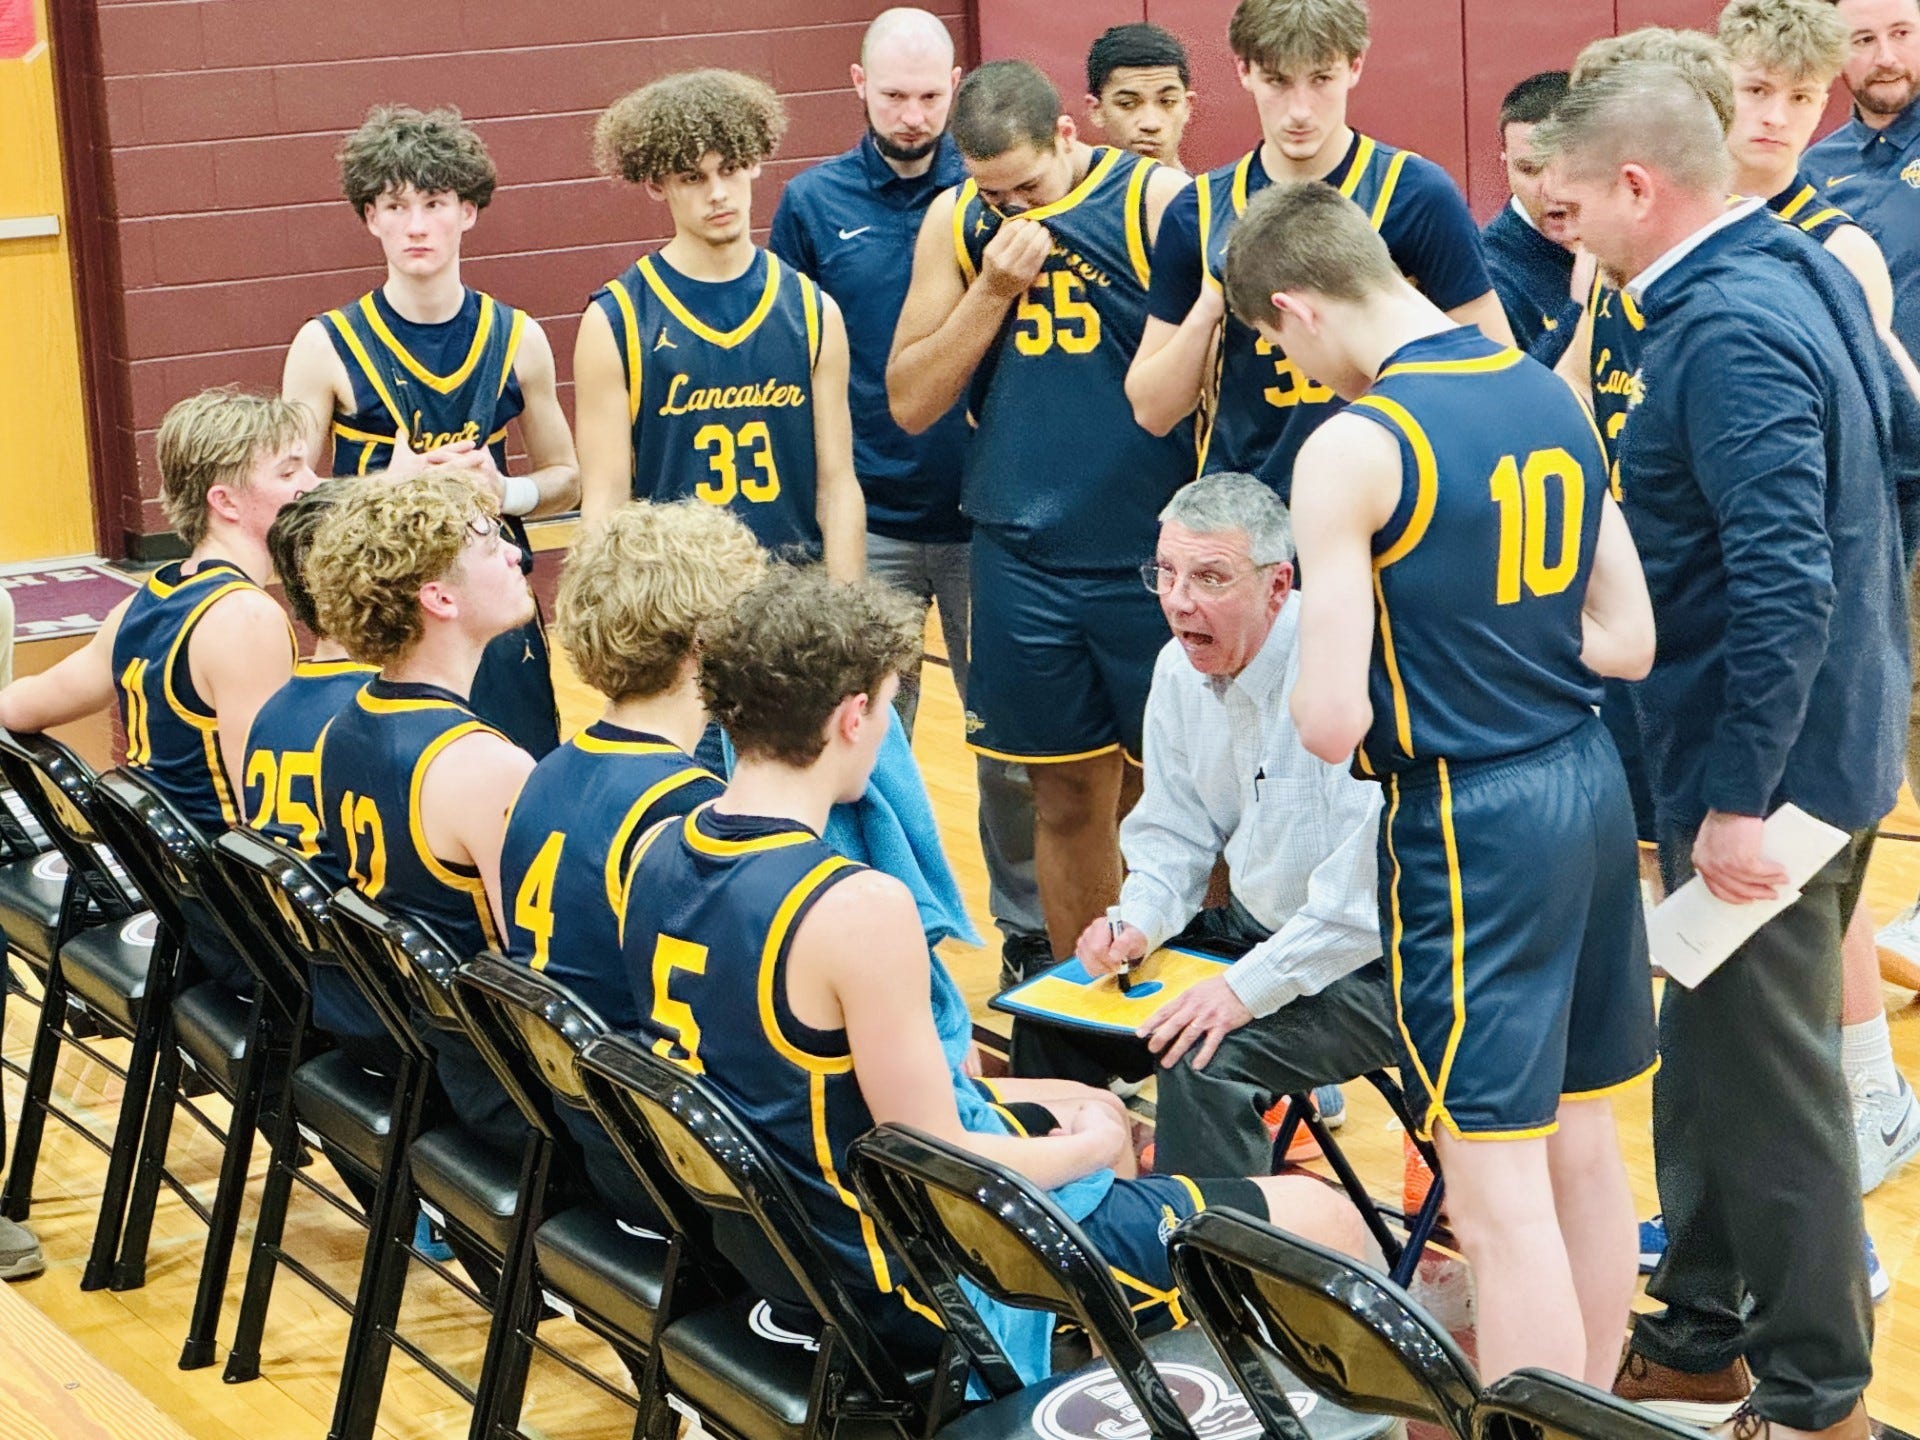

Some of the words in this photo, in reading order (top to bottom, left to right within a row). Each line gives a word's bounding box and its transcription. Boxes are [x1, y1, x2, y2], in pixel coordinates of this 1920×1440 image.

[1015, 270, 1100, 356] 55
[659, 374, 805, 416] Lancaster
[694, 421, 781, 505] 33
[1490, 447, 1584, 605] 10
[121, 657, 154, 771] 11
[245, 750, 322, 860] 25
[515, 831, 566, 972] 4
[652, 933, 708, 1076] 5
